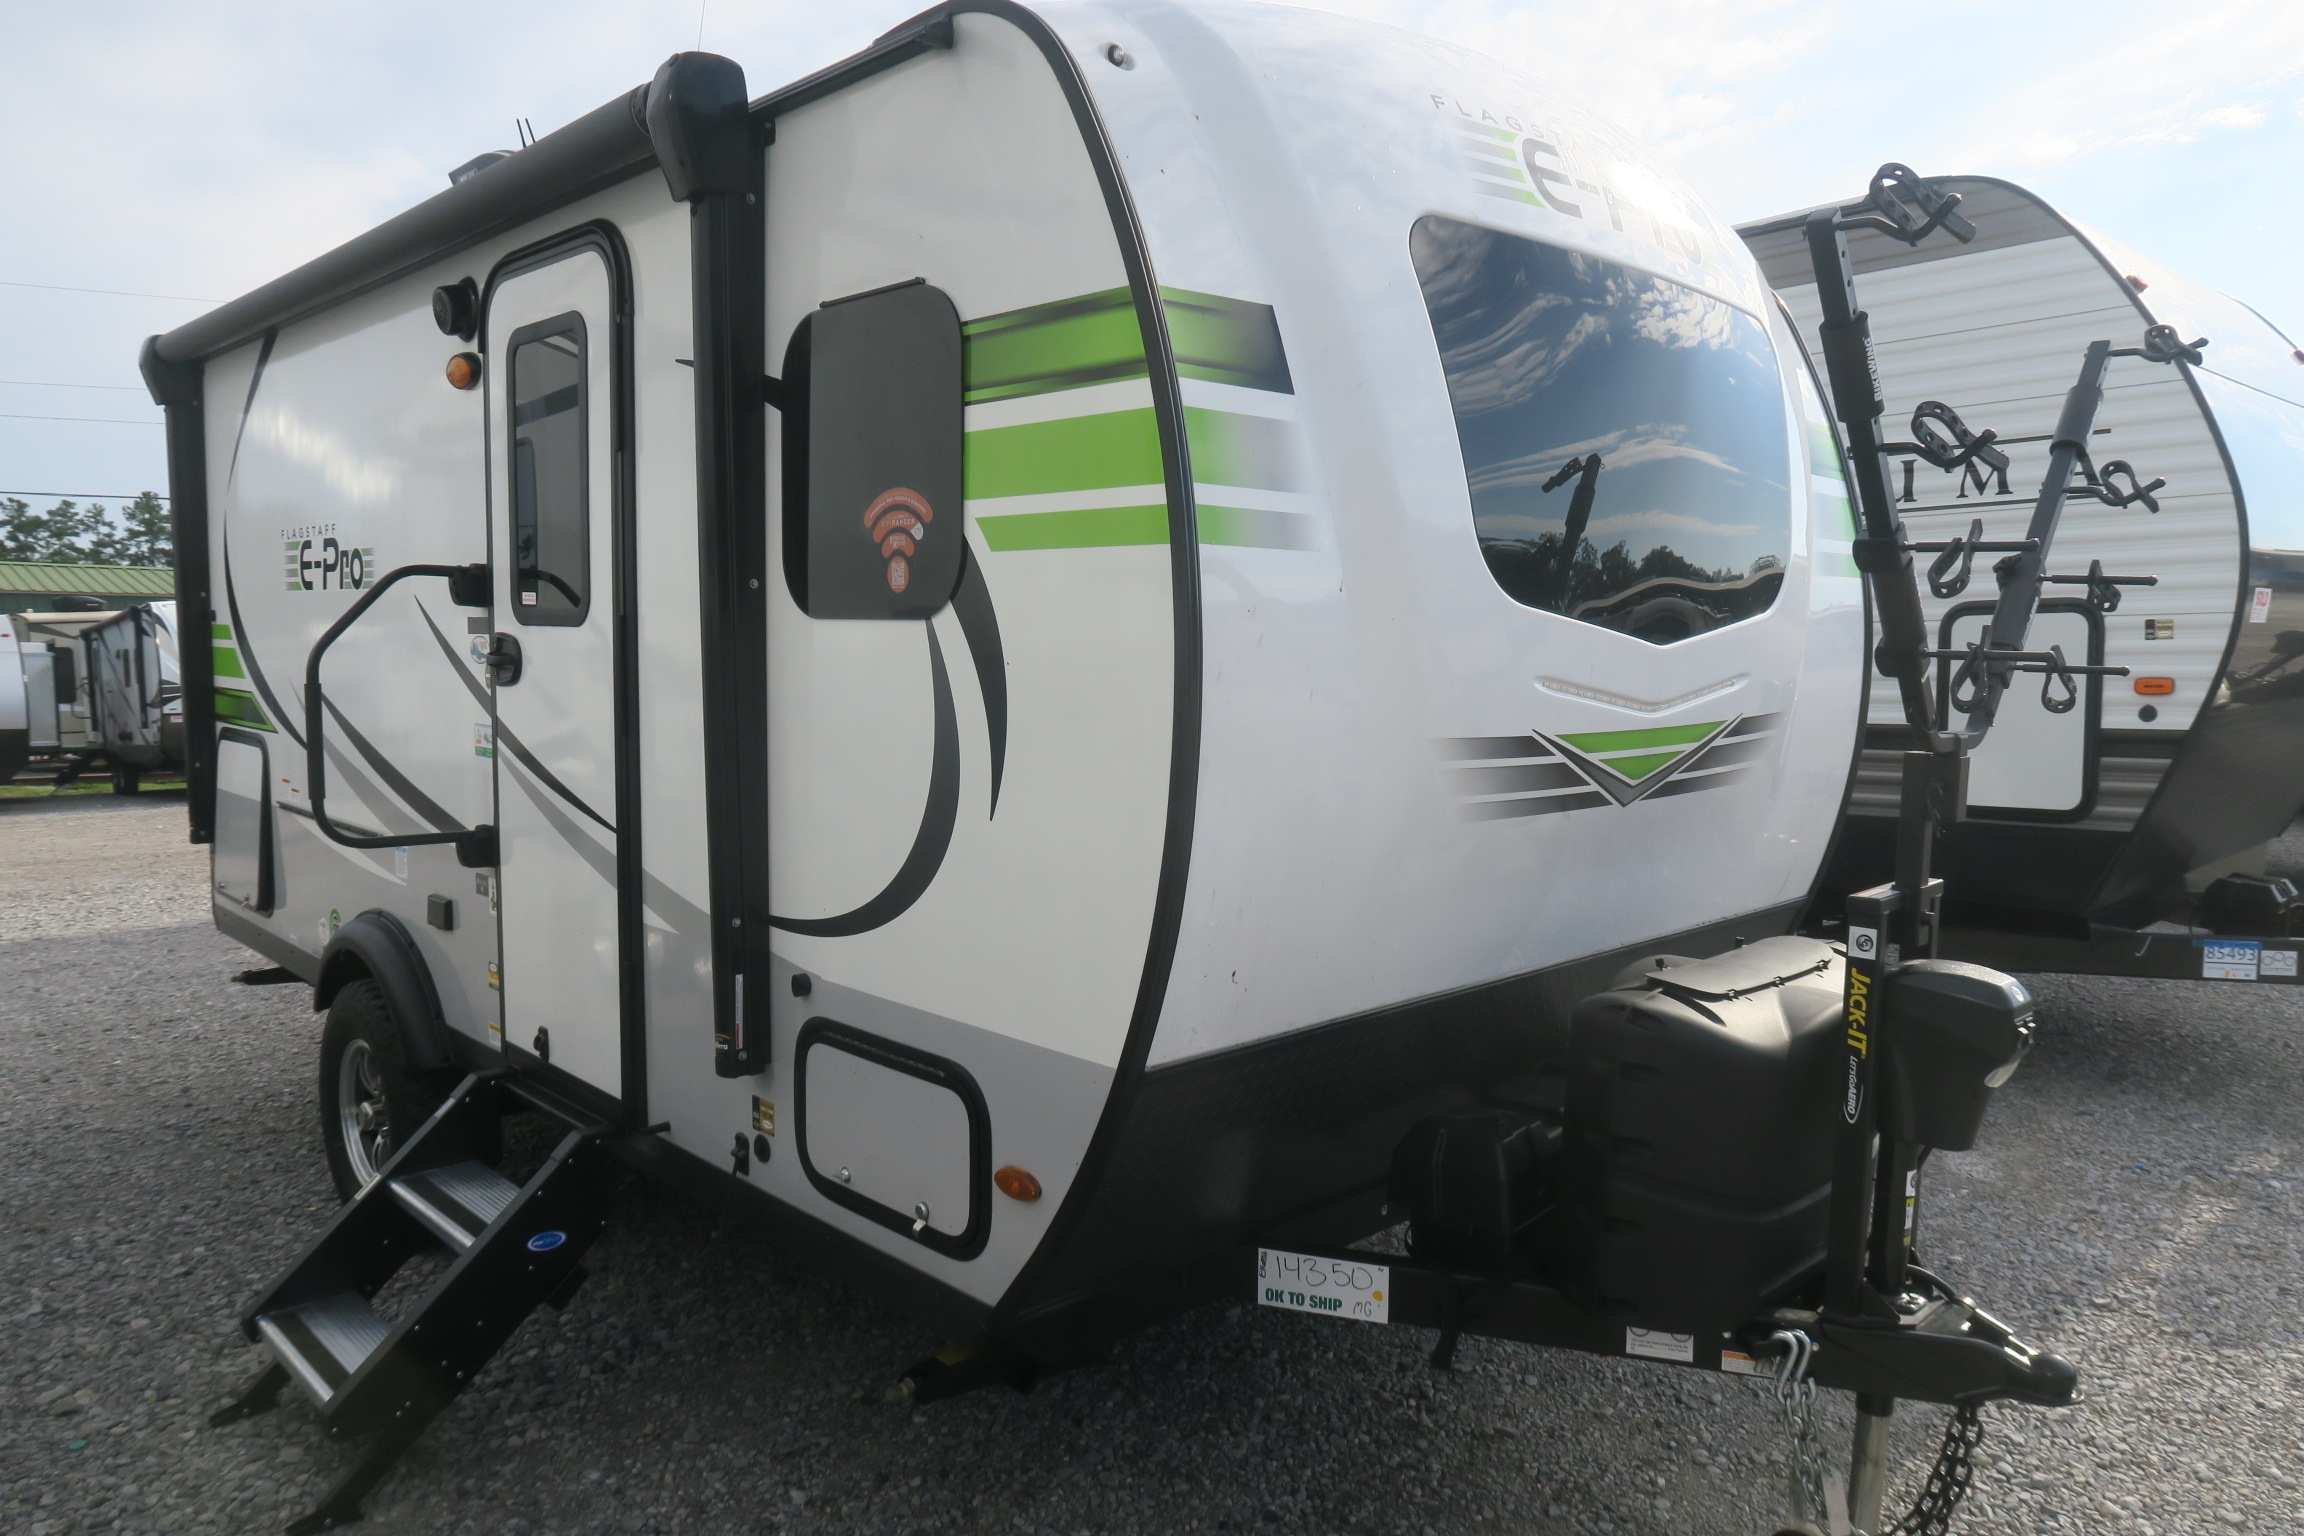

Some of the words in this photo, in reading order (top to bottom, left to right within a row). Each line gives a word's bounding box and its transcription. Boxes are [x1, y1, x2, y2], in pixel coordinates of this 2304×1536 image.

[1864, 337, 1882, 402] BIKEWING
[281, 523, 336, 540] FLAGSTAFF
[2206, 946, 2256, 961] 85493
[1276, 1256, 1373, 1290] 14350
[1265, 1288, 1285, 1302] OK
[1288, 1291, 1305, 1306] TO
[1309, 1295, 1342, 1312] SHIP
